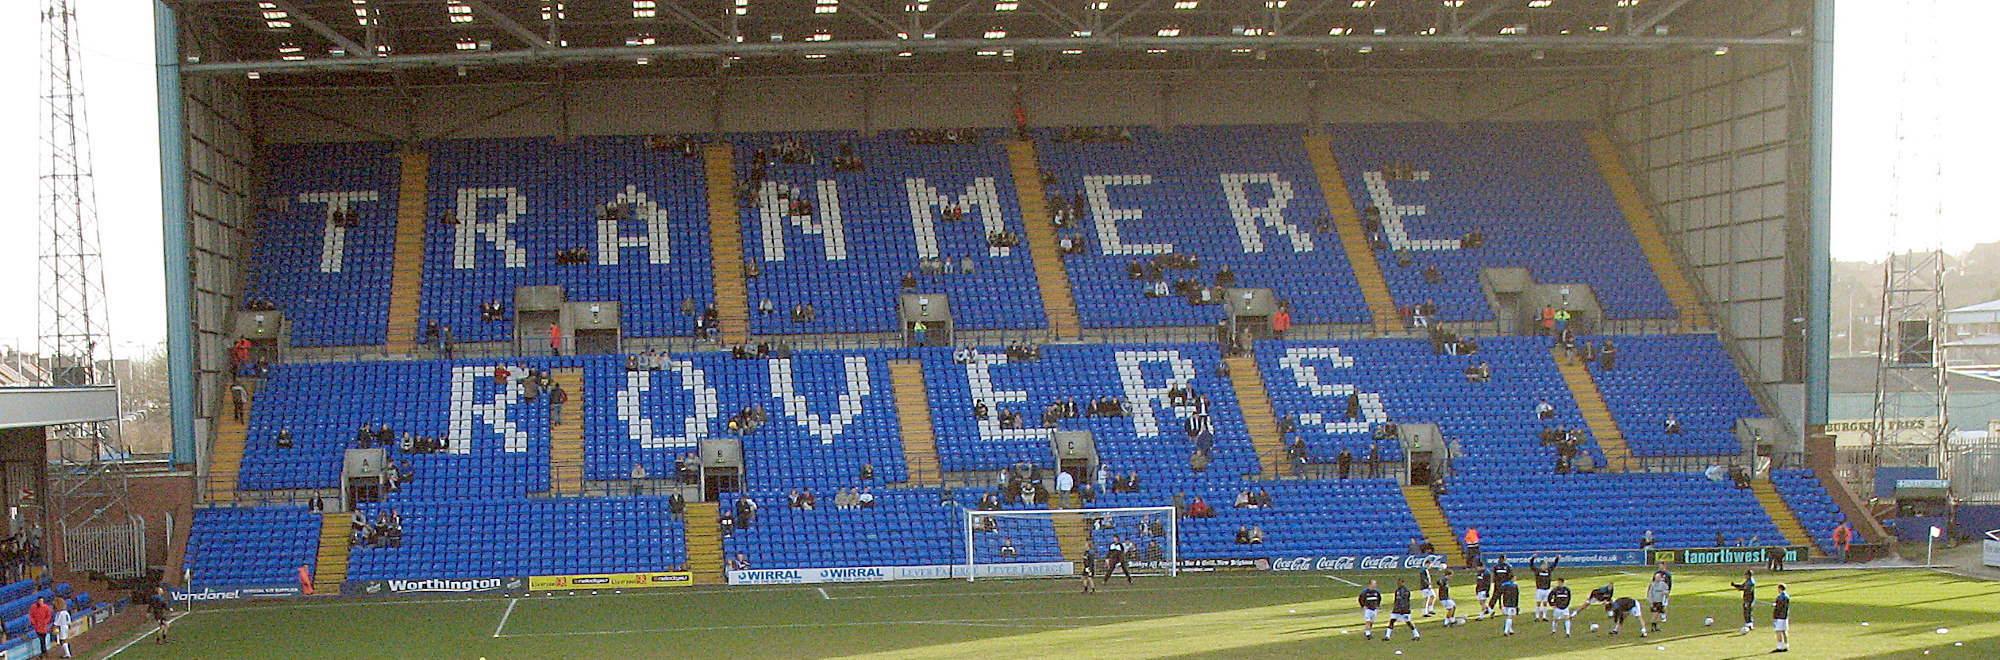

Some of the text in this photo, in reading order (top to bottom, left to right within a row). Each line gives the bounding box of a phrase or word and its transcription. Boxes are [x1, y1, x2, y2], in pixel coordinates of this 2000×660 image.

[300, 171, 1461, 272] TRANMERE
[448, 345, 1387, 454] ROVERS
[1888, 419, 1925, 430] FRIES
[1684, 548, 1798, 563] tanorthwest.m
[748, 569, 802, 580] WIRRAL
[831, 568, 885, 579] WIRRAL
[388, 578, 501, 592] Worthington
[171, 587, 241, 602] Vandanel
